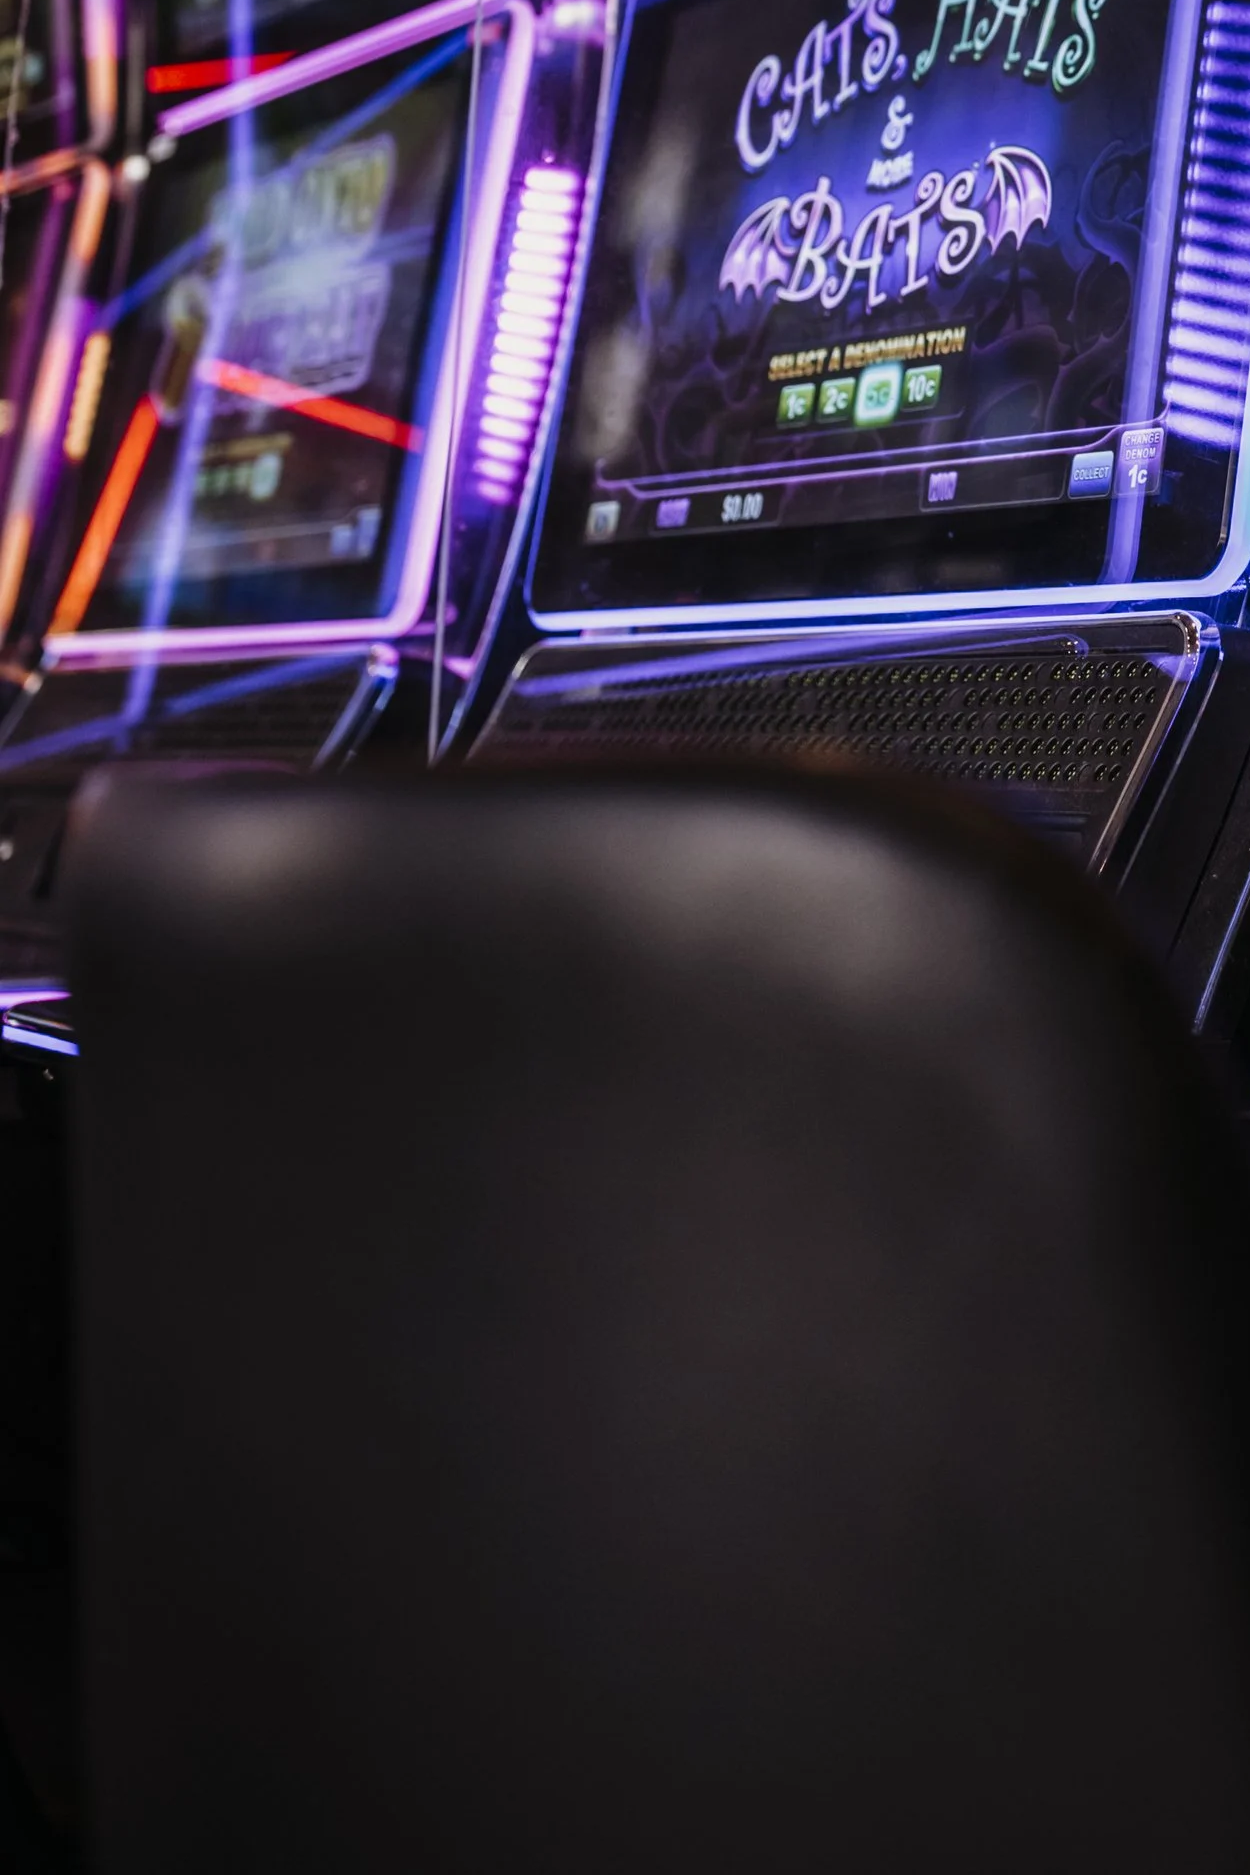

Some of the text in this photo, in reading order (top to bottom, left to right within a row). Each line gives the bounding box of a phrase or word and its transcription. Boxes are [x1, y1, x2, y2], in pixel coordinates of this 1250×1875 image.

[881, 94, 913, 150] &
[776, 170, 987, 313] BATS
[768, 326, 966, 381] SELECT A DENOMINATION
[1125, 432, 1160, 445] CHANGE
[1125, 448, 1156, 460] DENOM
[1073, 466, 1110, 480] COLLECT
